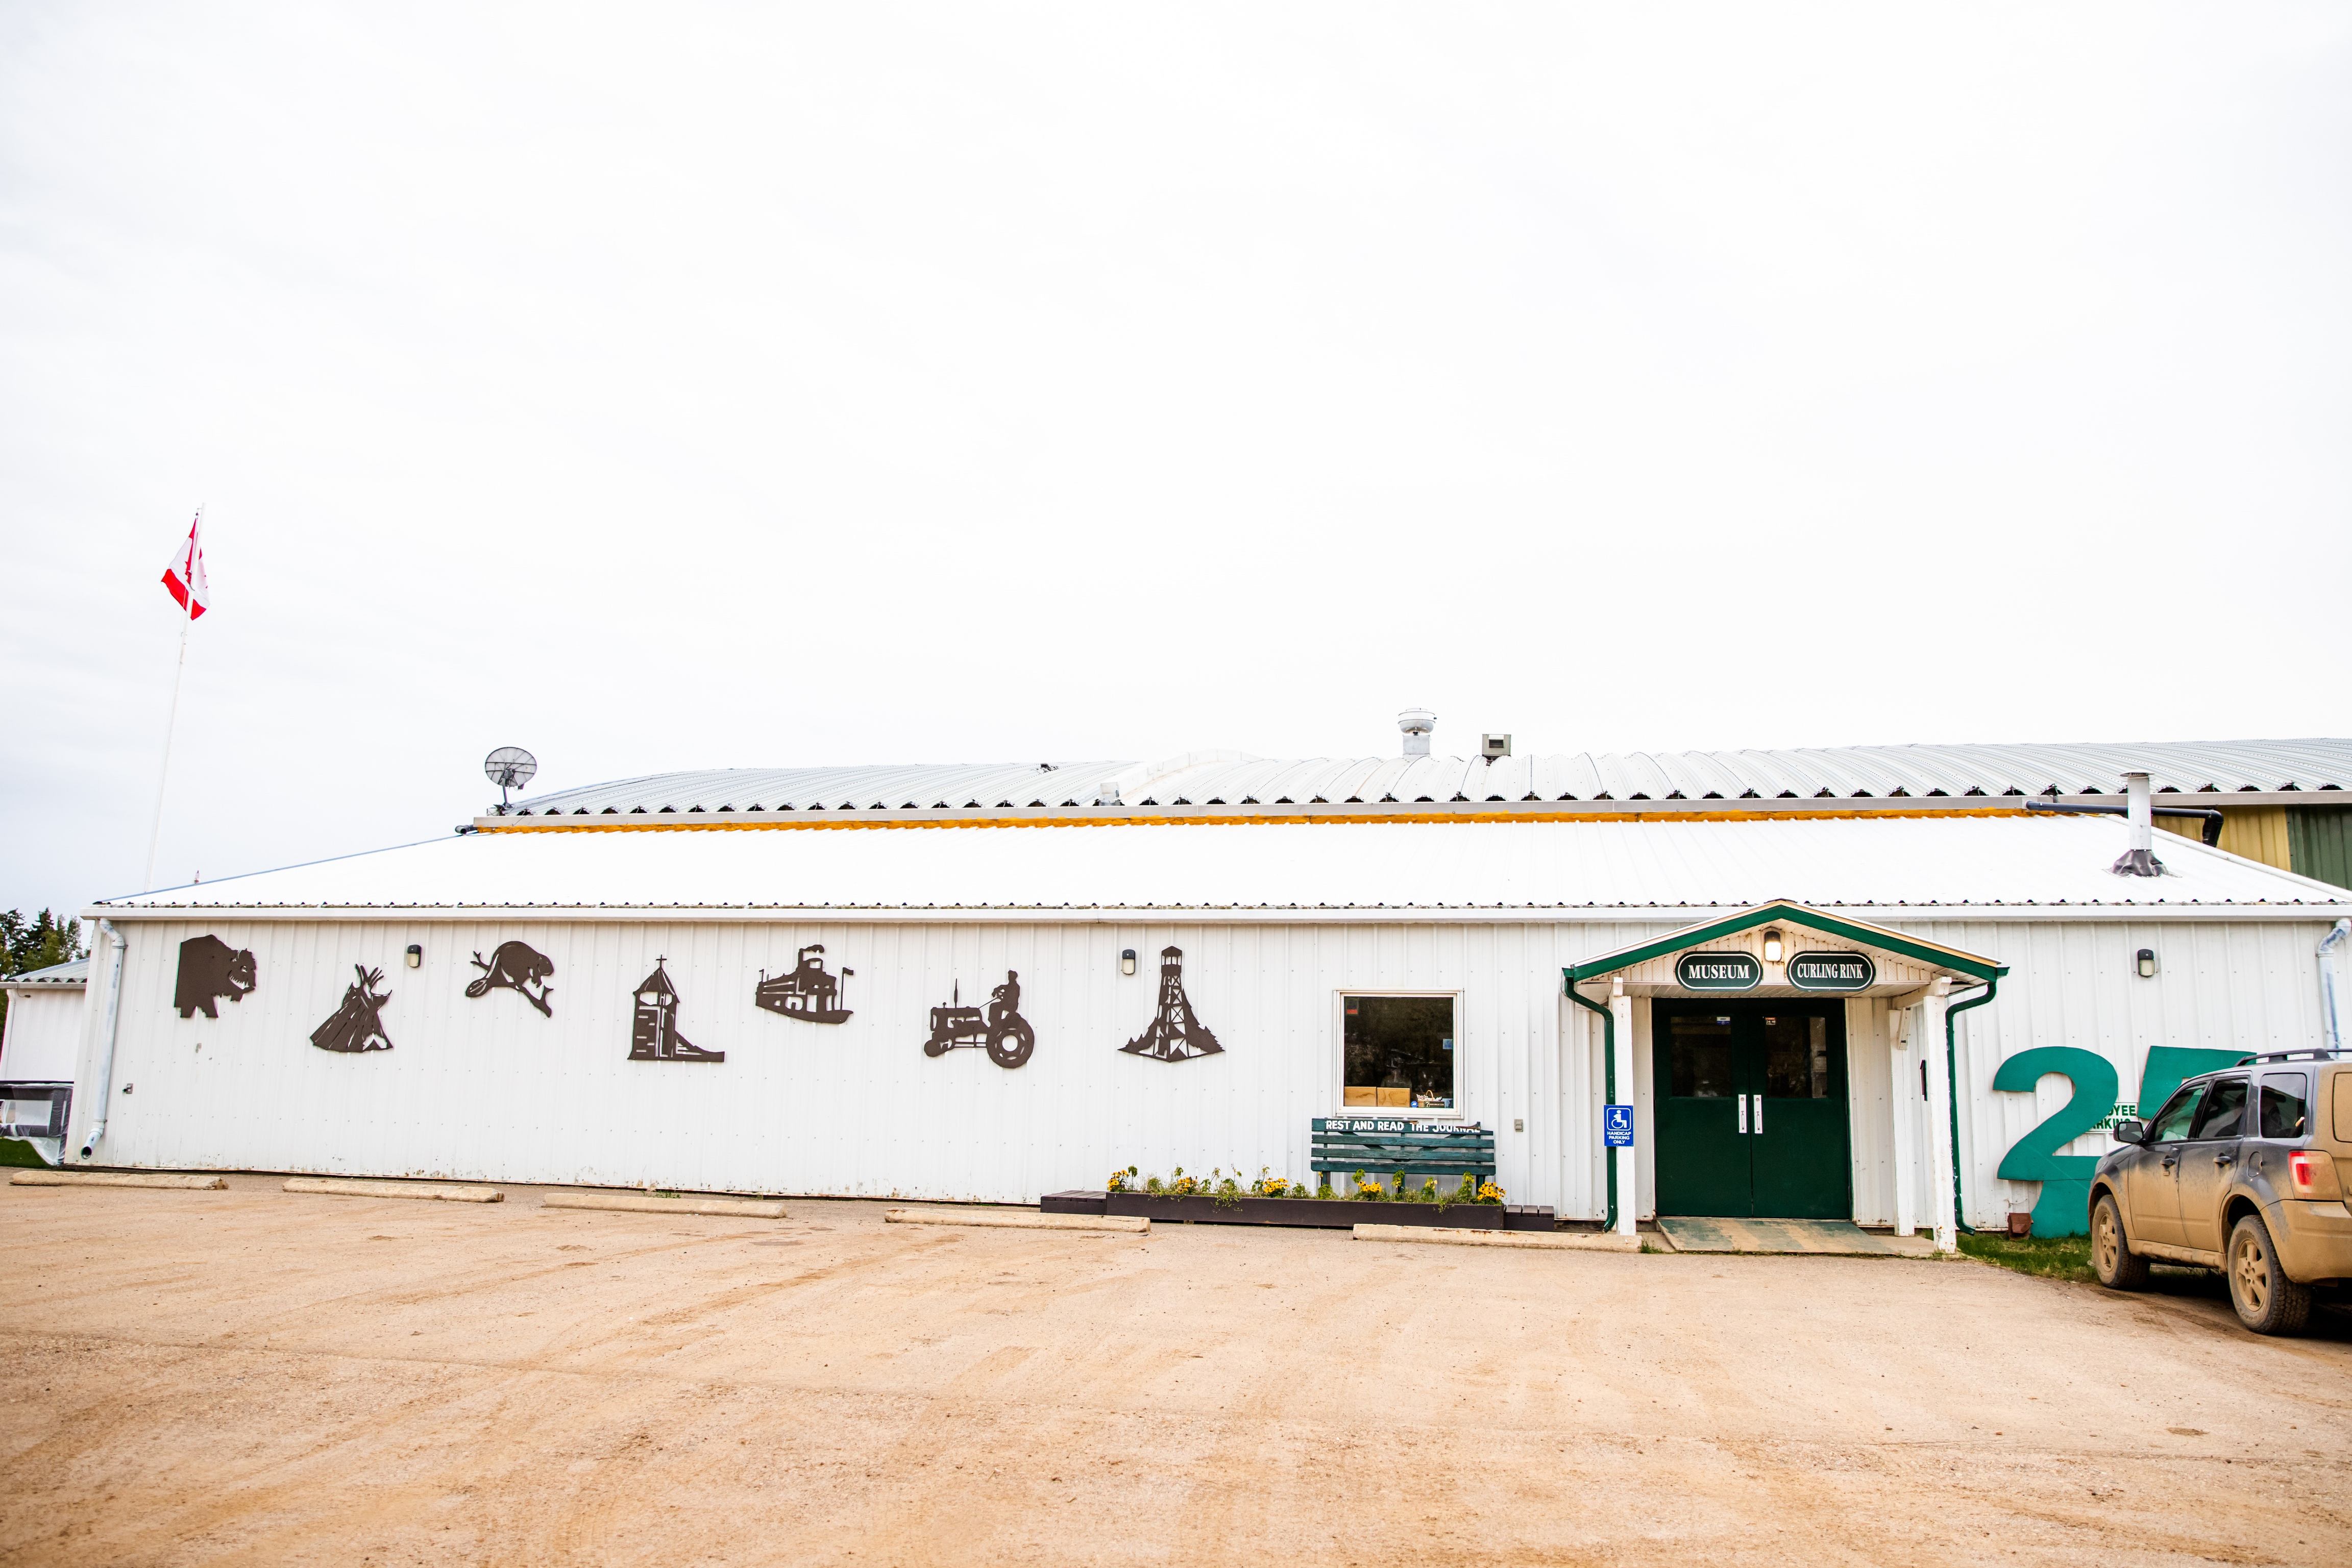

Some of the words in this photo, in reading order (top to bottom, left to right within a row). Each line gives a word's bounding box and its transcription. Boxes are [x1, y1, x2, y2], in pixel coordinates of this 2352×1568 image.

[1688, 965, 1750, 979] MUSEUM
[1797, 963, 1839, 978] CURLING
[1840, 964, 1864, 978] RINK
[1326, 1120, 1351, 1130] REST
[1353, 1120, 1375, 1130] AND
[1377, 1121, 1404, 1131] READ
[1409, 1122, 1429, 1131] THE
